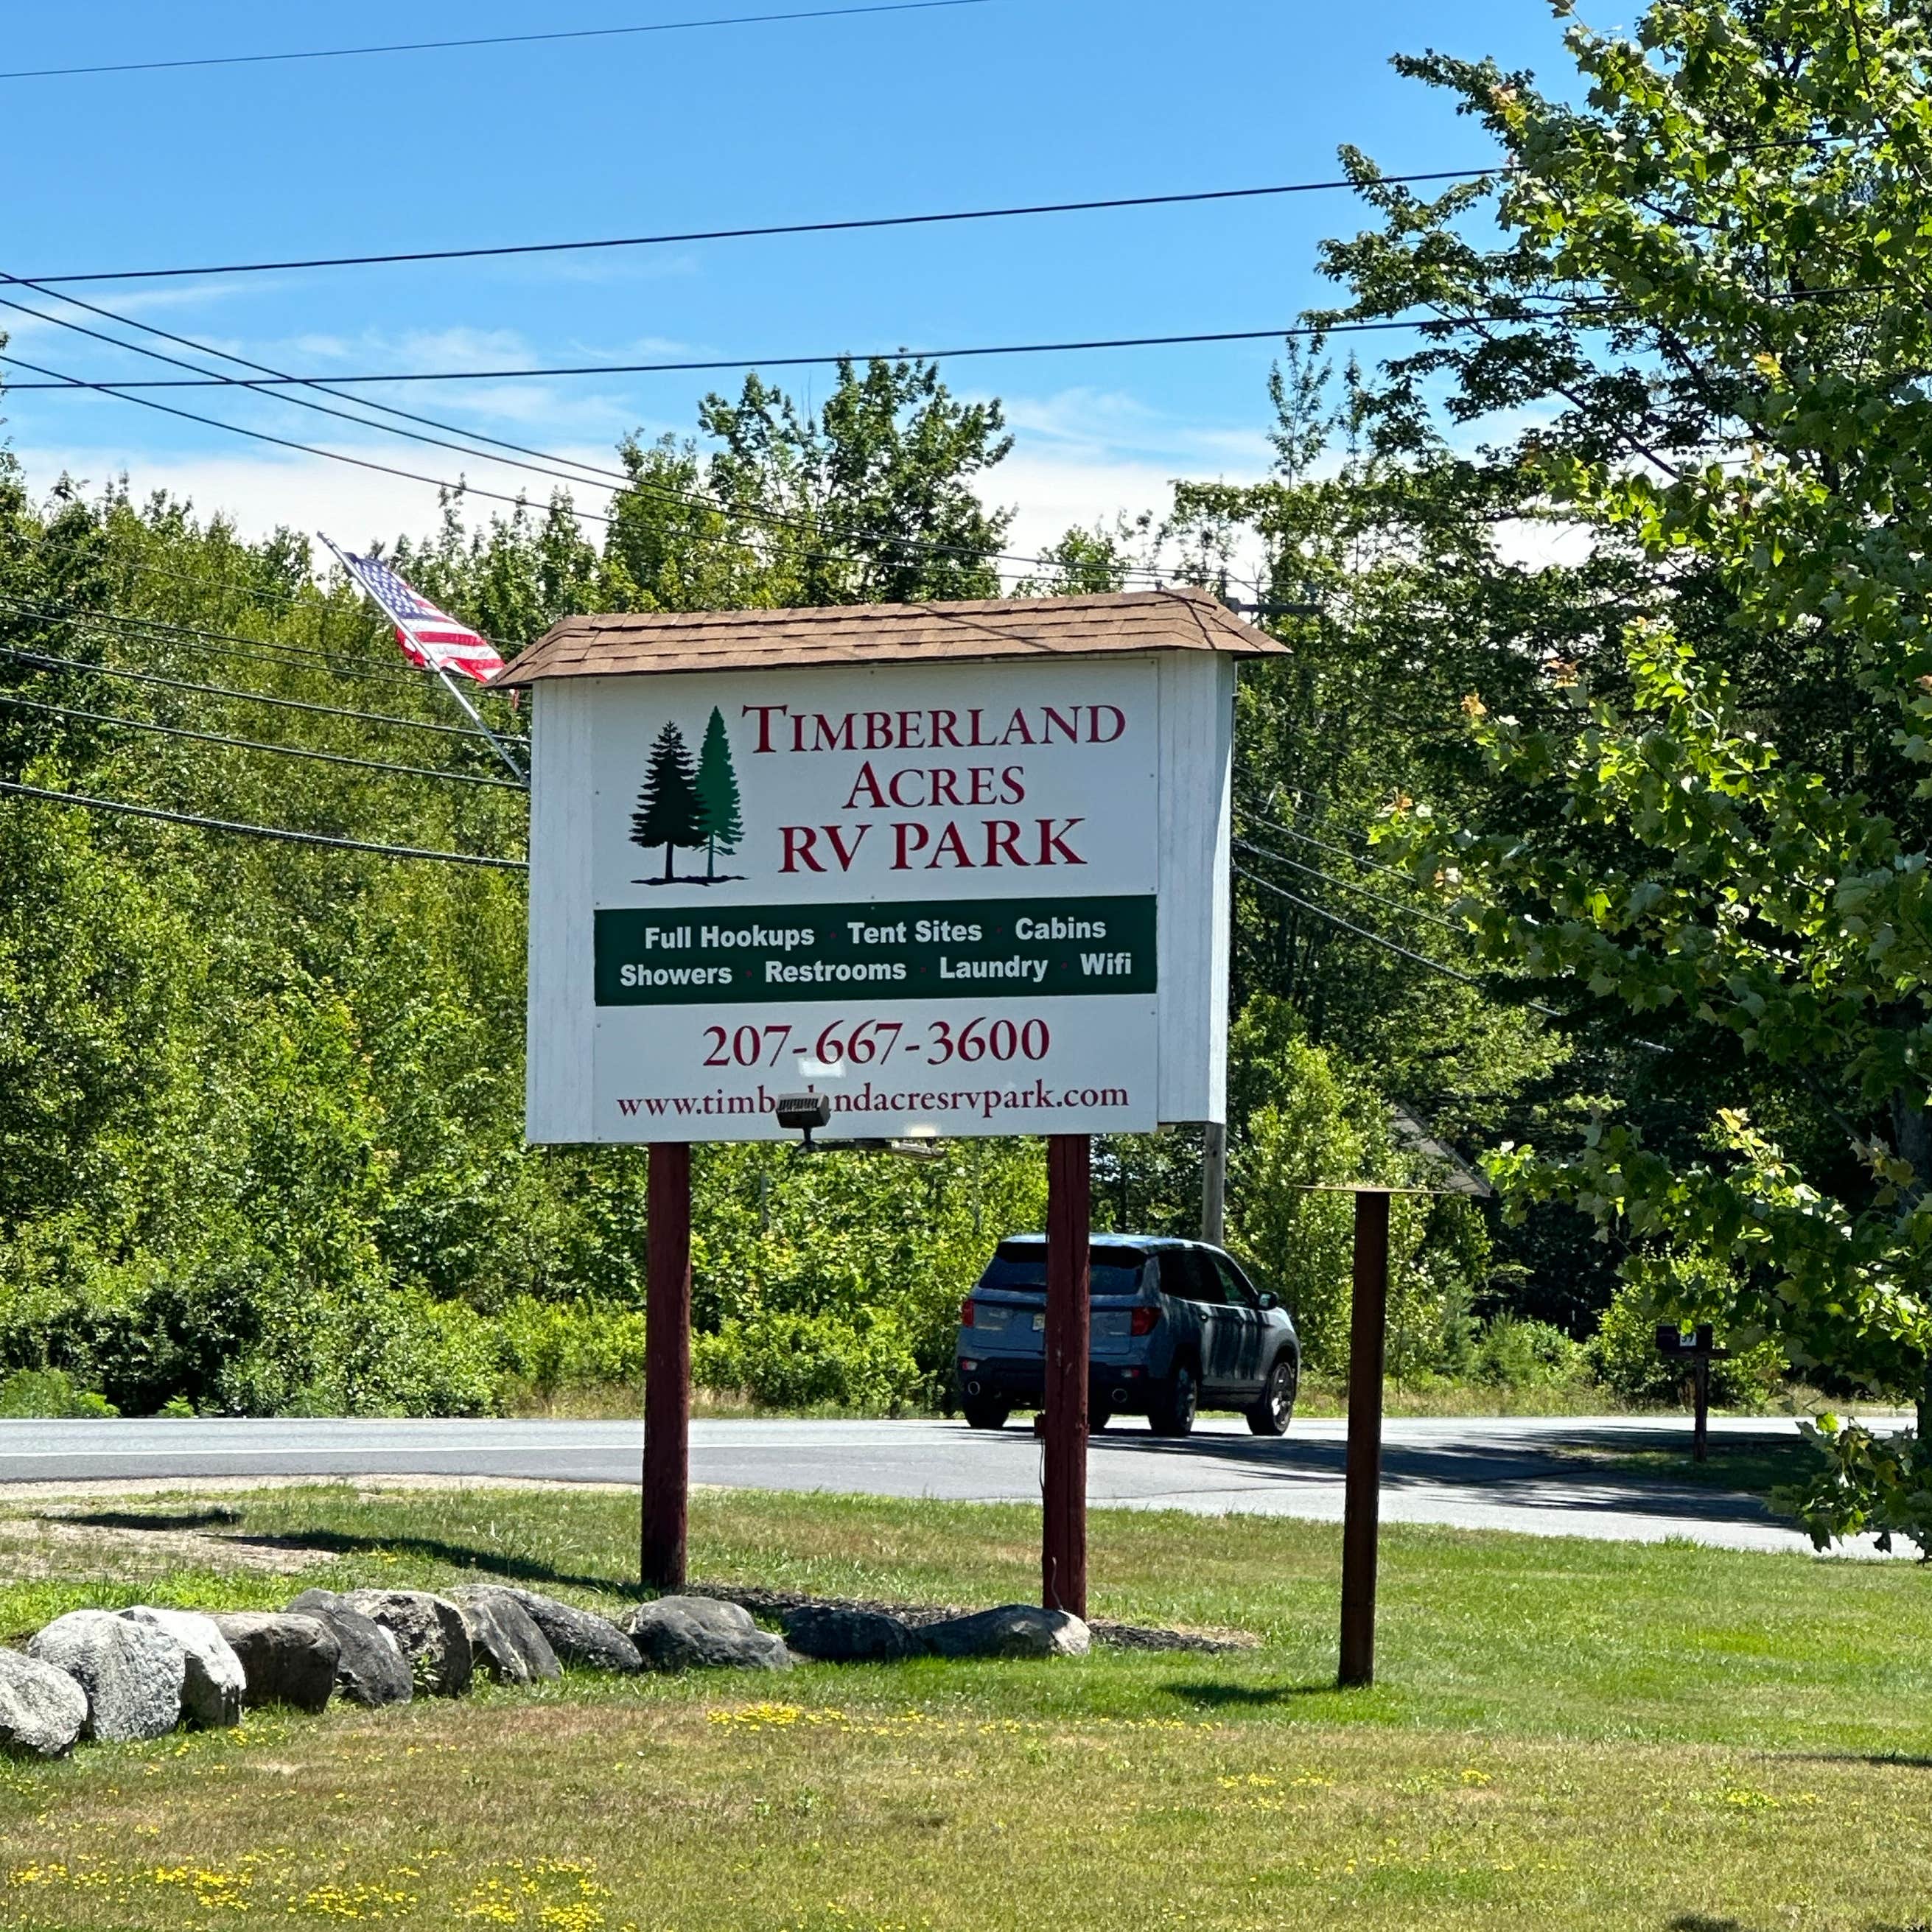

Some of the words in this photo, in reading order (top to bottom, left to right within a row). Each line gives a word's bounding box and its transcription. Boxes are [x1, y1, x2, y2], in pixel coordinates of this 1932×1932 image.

[741, 704, 1126, 754] TIMBERLAND
[841, 760, 1025, 810] ACRES
[777, 824, 869, 873] RV
[889, 818, 1088, 870] PARK
[645, 926, 691, 949] Full
[701, 925, 815, 951] Hookups
[847, 922, 906, 944] Tent
[915, 920, 982, 942] Sites
[1015, 917, 1106, 940] Cabins
[620, 964, 732, 987] Showers
[766, 960, 906, 982] Restrooms
[940, 955, 1048, 982] Laundry
[1080, 953, 1131, 975] Wifi
[702, 1016, 1050, 1068] 207-667-3600
[617, 1079, 1130, 1119] www.timbndacresrvpark.com
